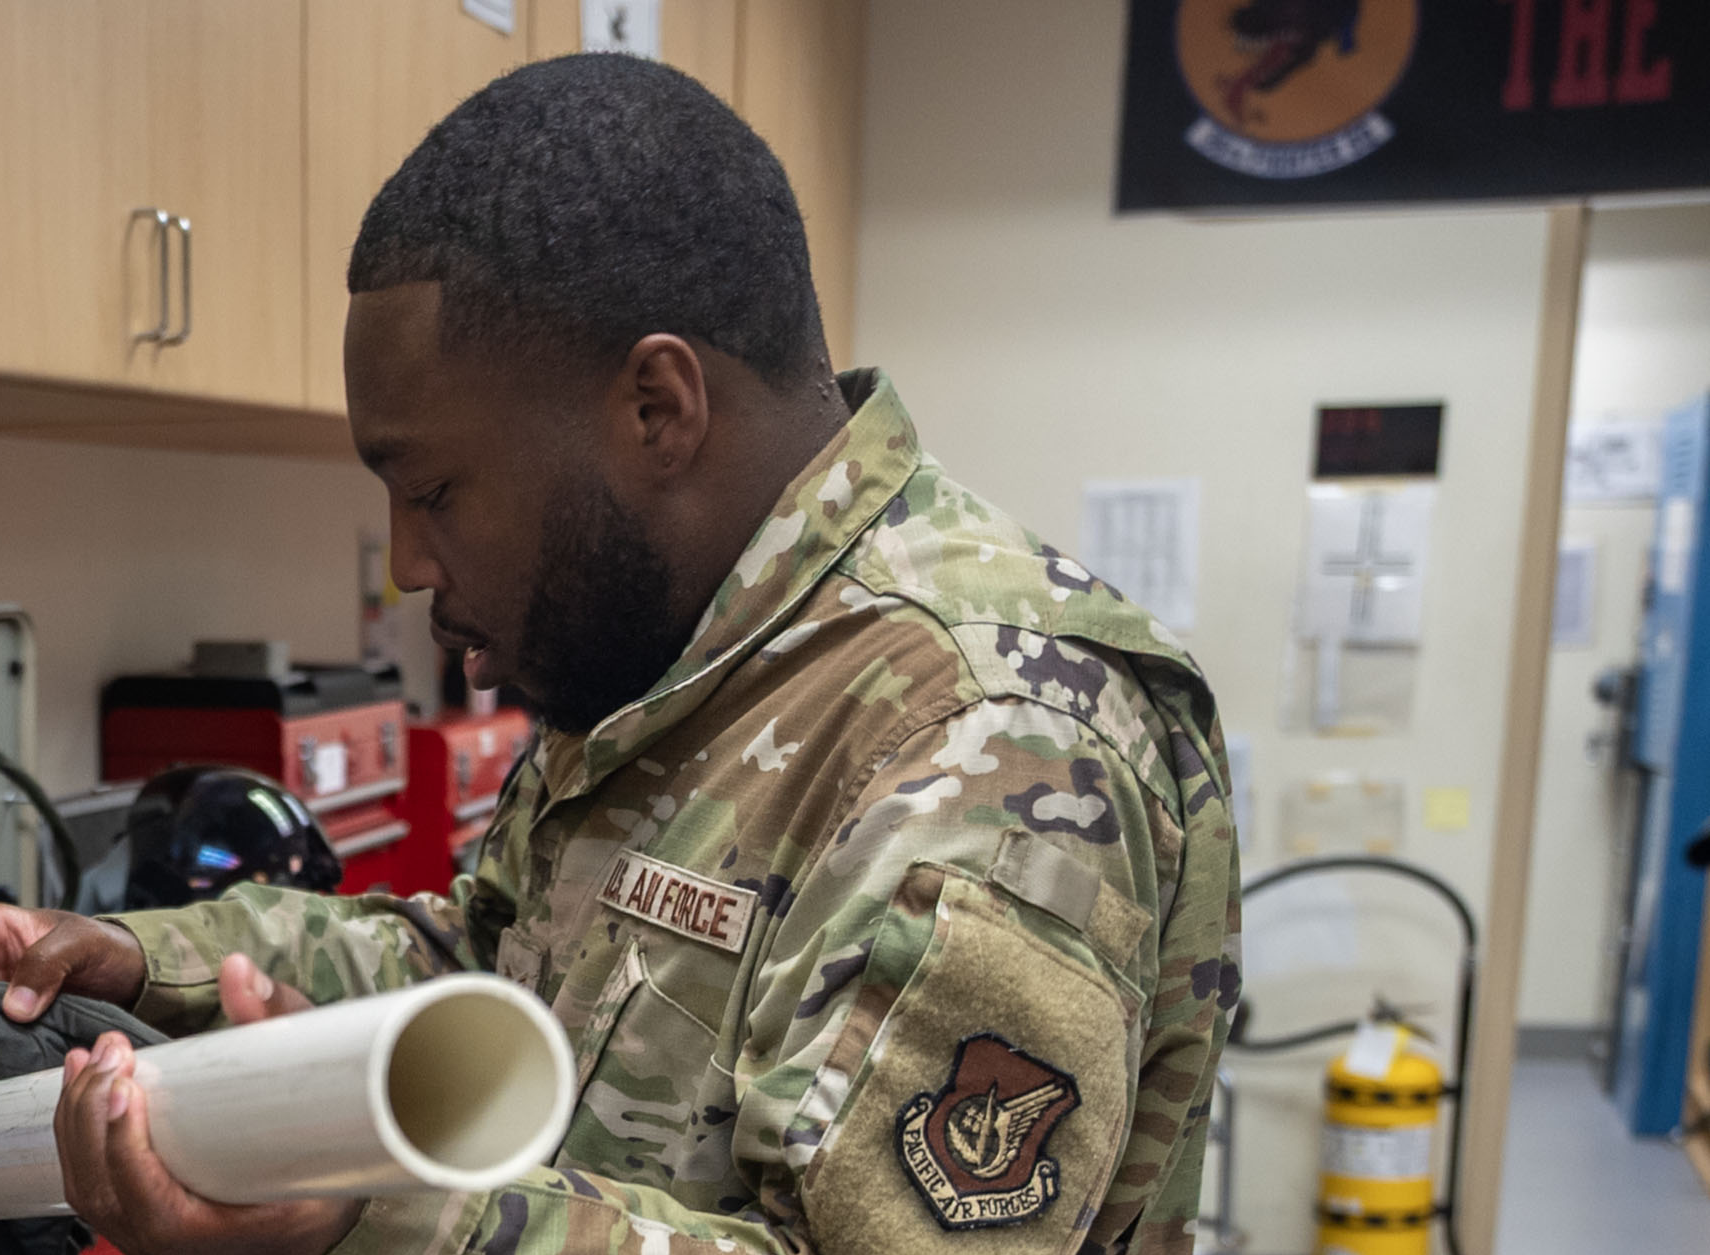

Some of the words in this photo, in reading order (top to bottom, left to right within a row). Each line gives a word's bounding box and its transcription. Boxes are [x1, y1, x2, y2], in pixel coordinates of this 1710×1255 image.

[1499, 0, 1672, 111] THE
[626, 868, 665, 915] AIR
[657, 877, 738, 940] FORCE
[905, 1128, 947, 1193] PACIFIC
[937, 1194, 974, 1219] AIR
[978, 1188, 1042, 1218] FORCES
